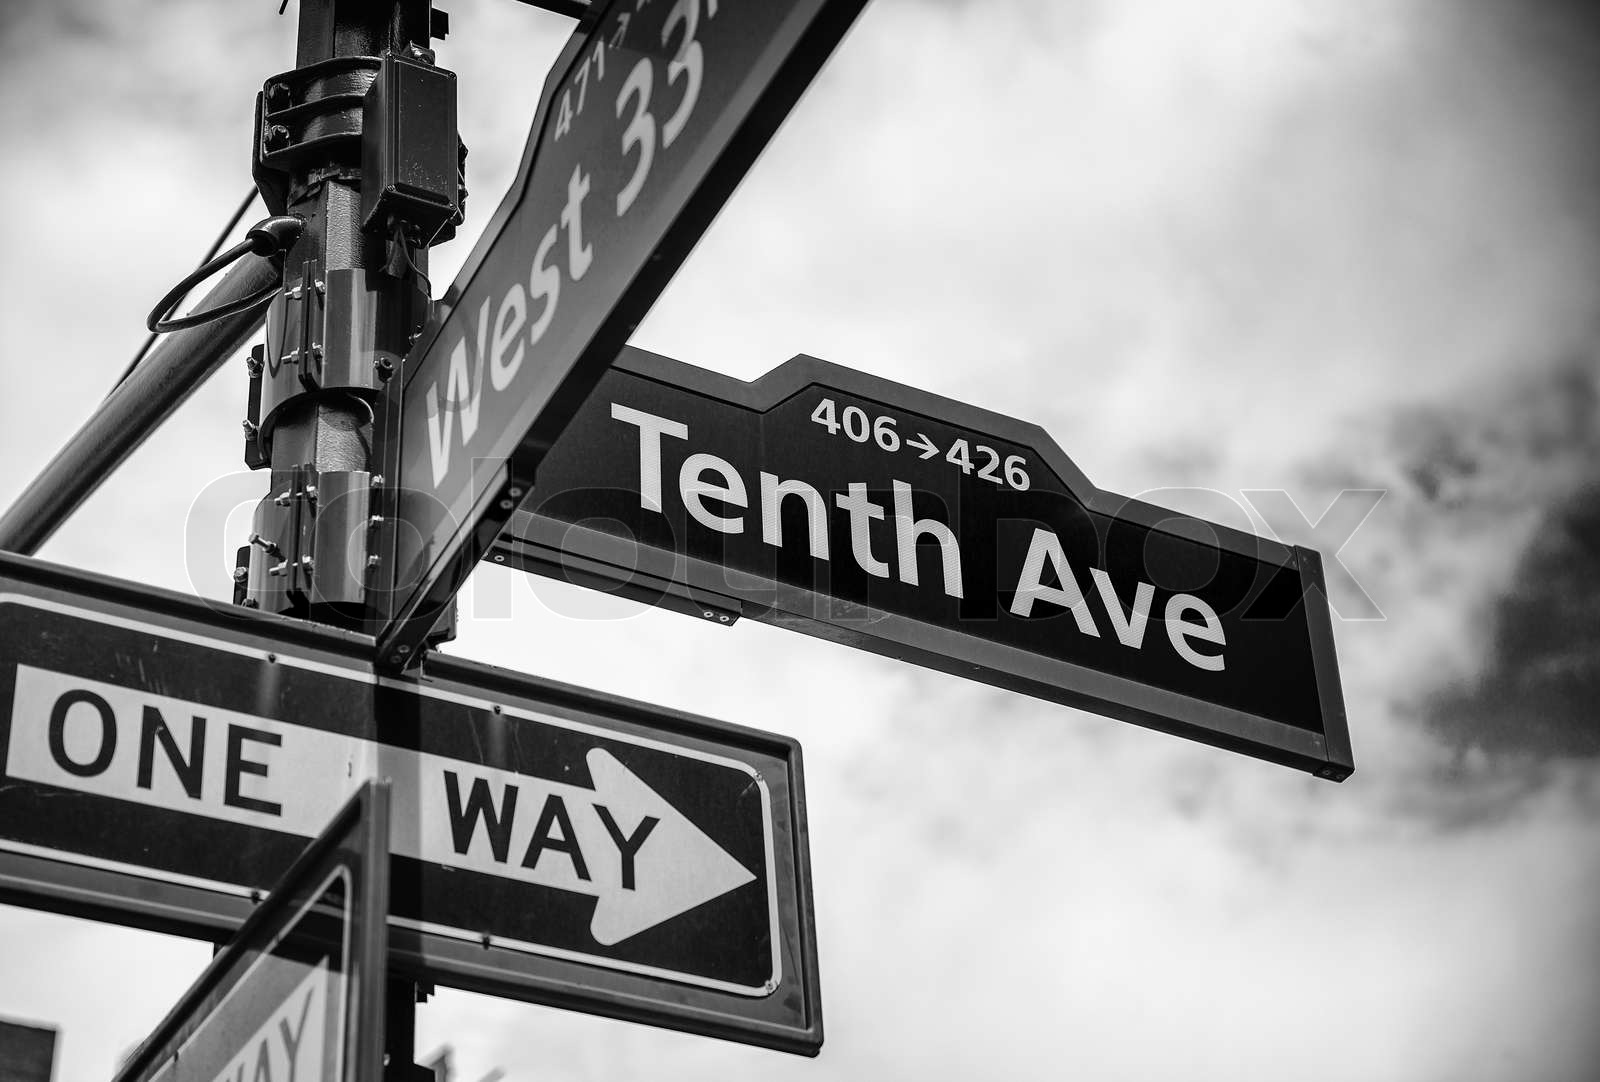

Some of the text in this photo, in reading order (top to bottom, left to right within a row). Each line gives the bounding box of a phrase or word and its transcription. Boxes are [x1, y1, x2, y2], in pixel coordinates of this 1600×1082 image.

[554, 36, 605, 142] 471
[425, 163, 593, 489] West
[810, 398, 1030, 491] 406 426
[610, 402, 1227, 671] Tenth Ave
[48, 689, 661, 892] ONE WAY
[226, 986, 316, 1082] AY
